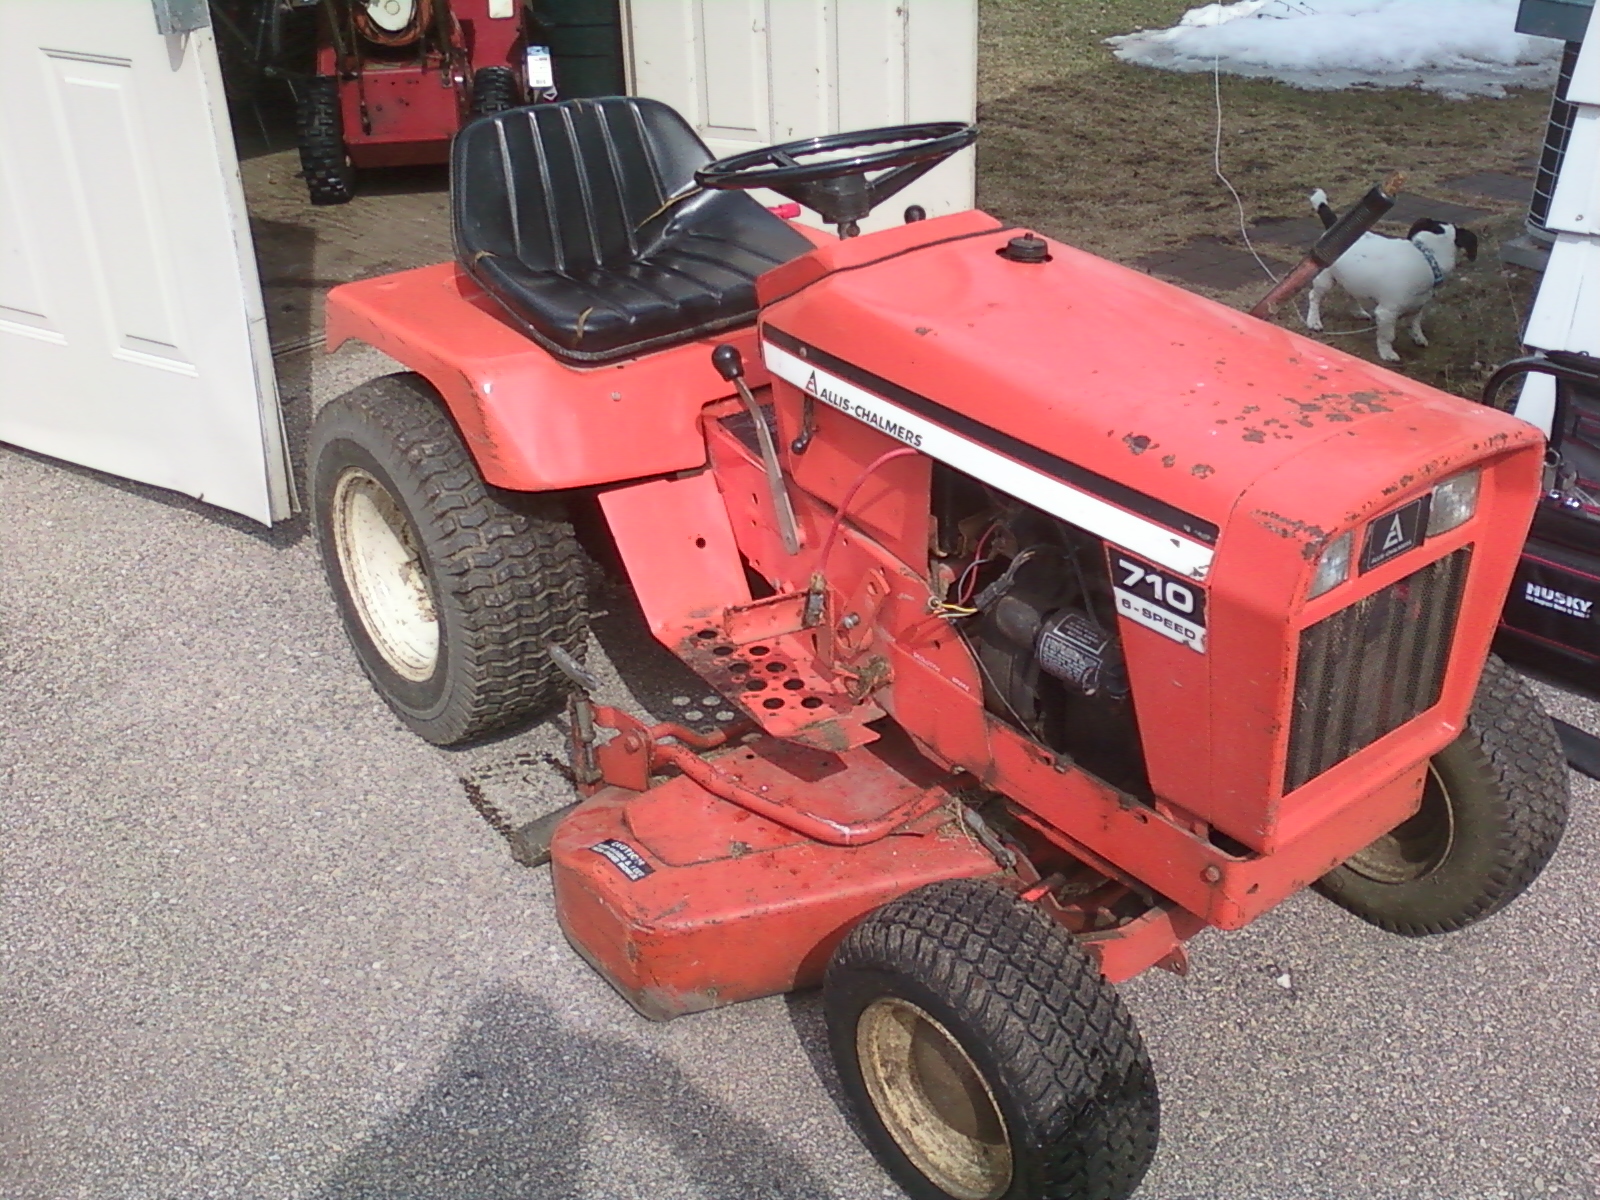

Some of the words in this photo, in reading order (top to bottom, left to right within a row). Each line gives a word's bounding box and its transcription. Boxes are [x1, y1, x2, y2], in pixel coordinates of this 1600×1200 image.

[820, 388, 923, 447] ALLIS-CHALMERS
[1119, 559, 1194, 614] 710
[1525, 582, 1593, 613] HUSKY
[1121, 598, 1196, 640] 6-SPEED
